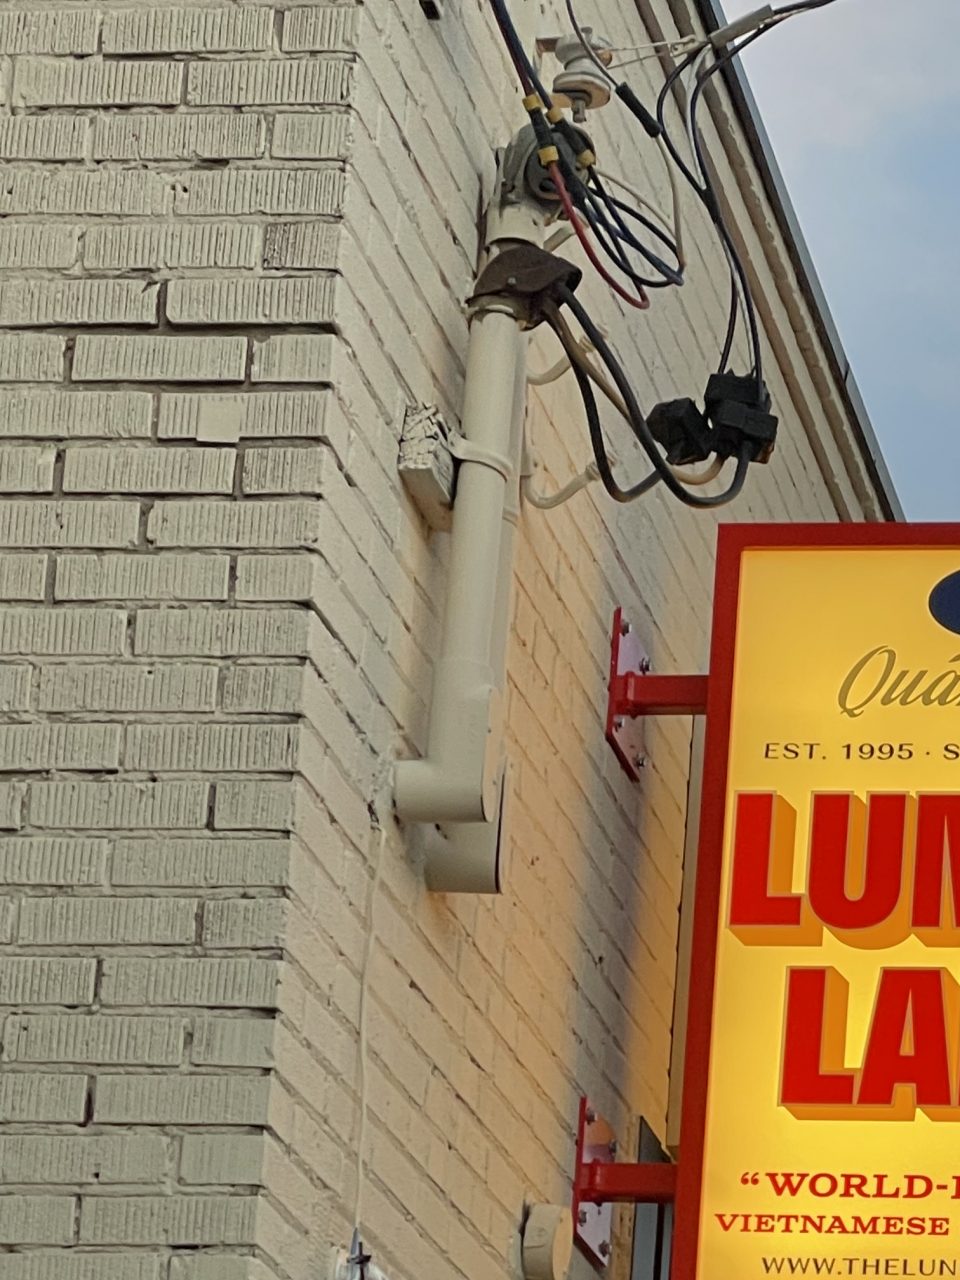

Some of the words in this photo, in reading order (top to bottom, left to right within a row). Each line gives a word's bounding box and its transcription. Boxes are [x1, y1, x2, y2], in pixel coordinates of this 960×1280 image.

[764, 742, 827, 760] EST.
[841, 742, 914, 760] 1995
[715, 1213, 950, 1237] VIETNAMESE
